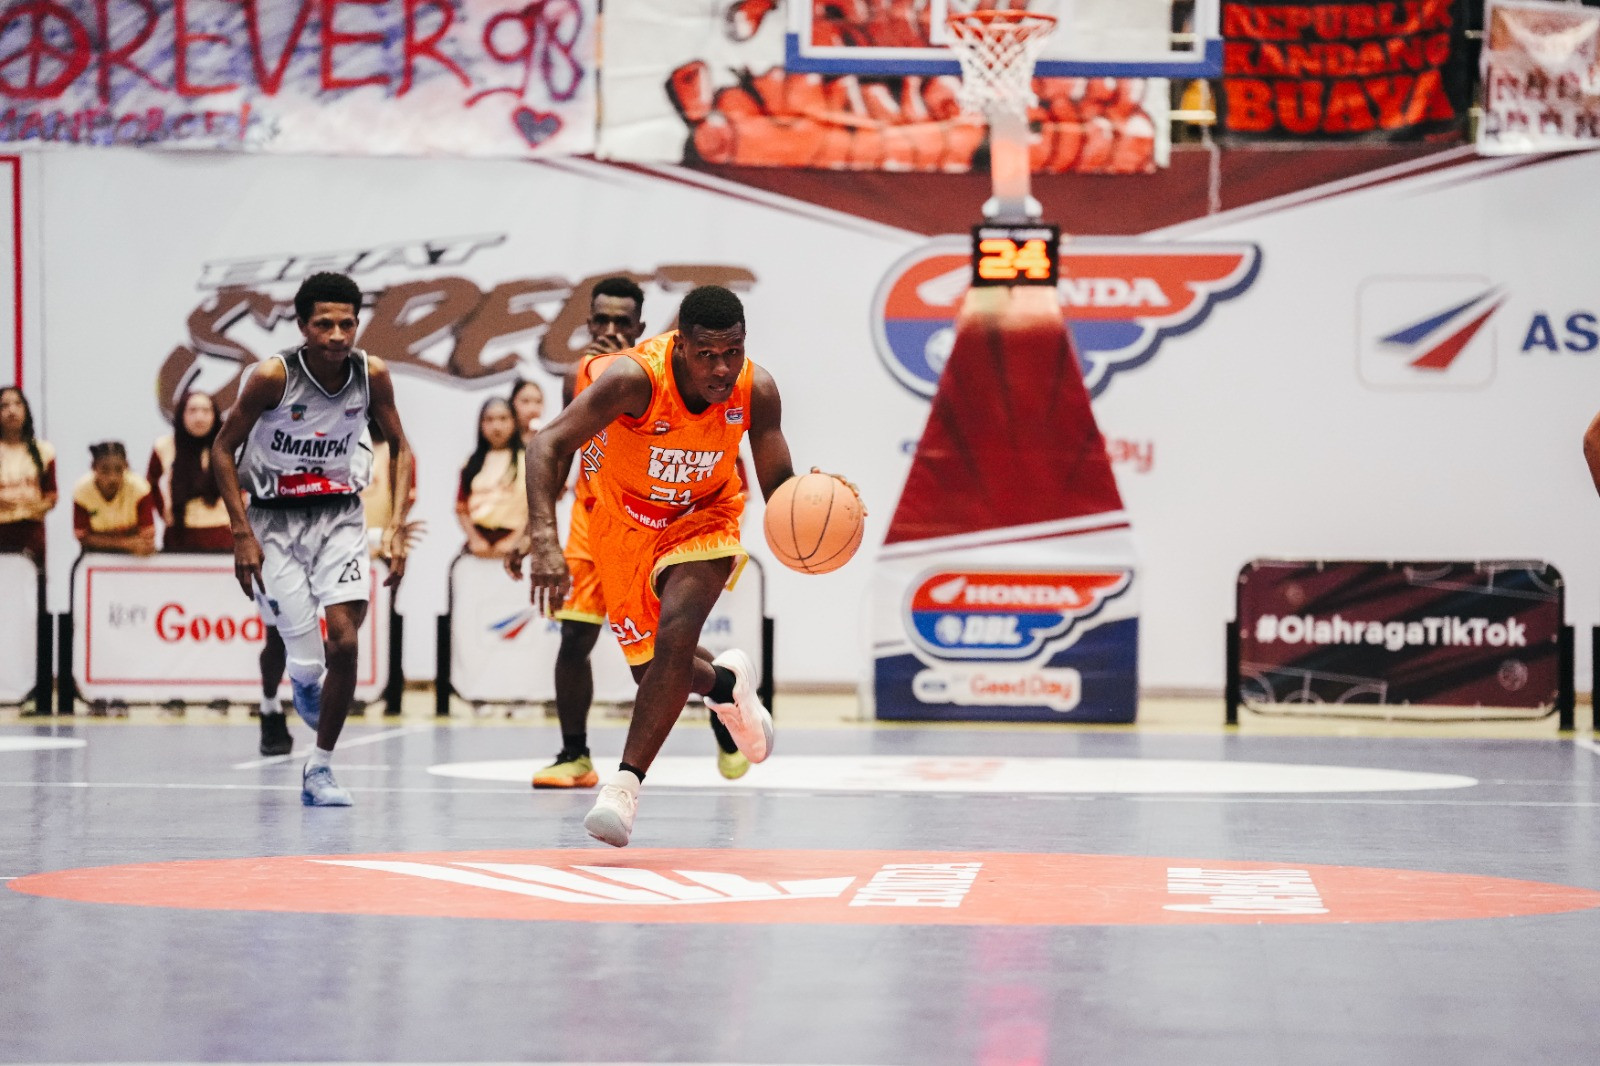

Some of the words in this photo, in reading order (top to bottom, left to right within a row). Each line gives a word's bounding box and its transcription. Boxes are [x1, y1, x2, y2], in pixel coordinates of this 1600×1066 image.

[1223, 69, 1454, 133] BUAYA
[979, 239, 1050, 279] 24
[1057, 278, 1171, 307] NDA
[624, 504, 640, 520] One
[337, 558, 362, 584] 23
[964, 584, 1080, 604] HONDA
[1255, 614, 1527, 651] #OlahragaTikTok
